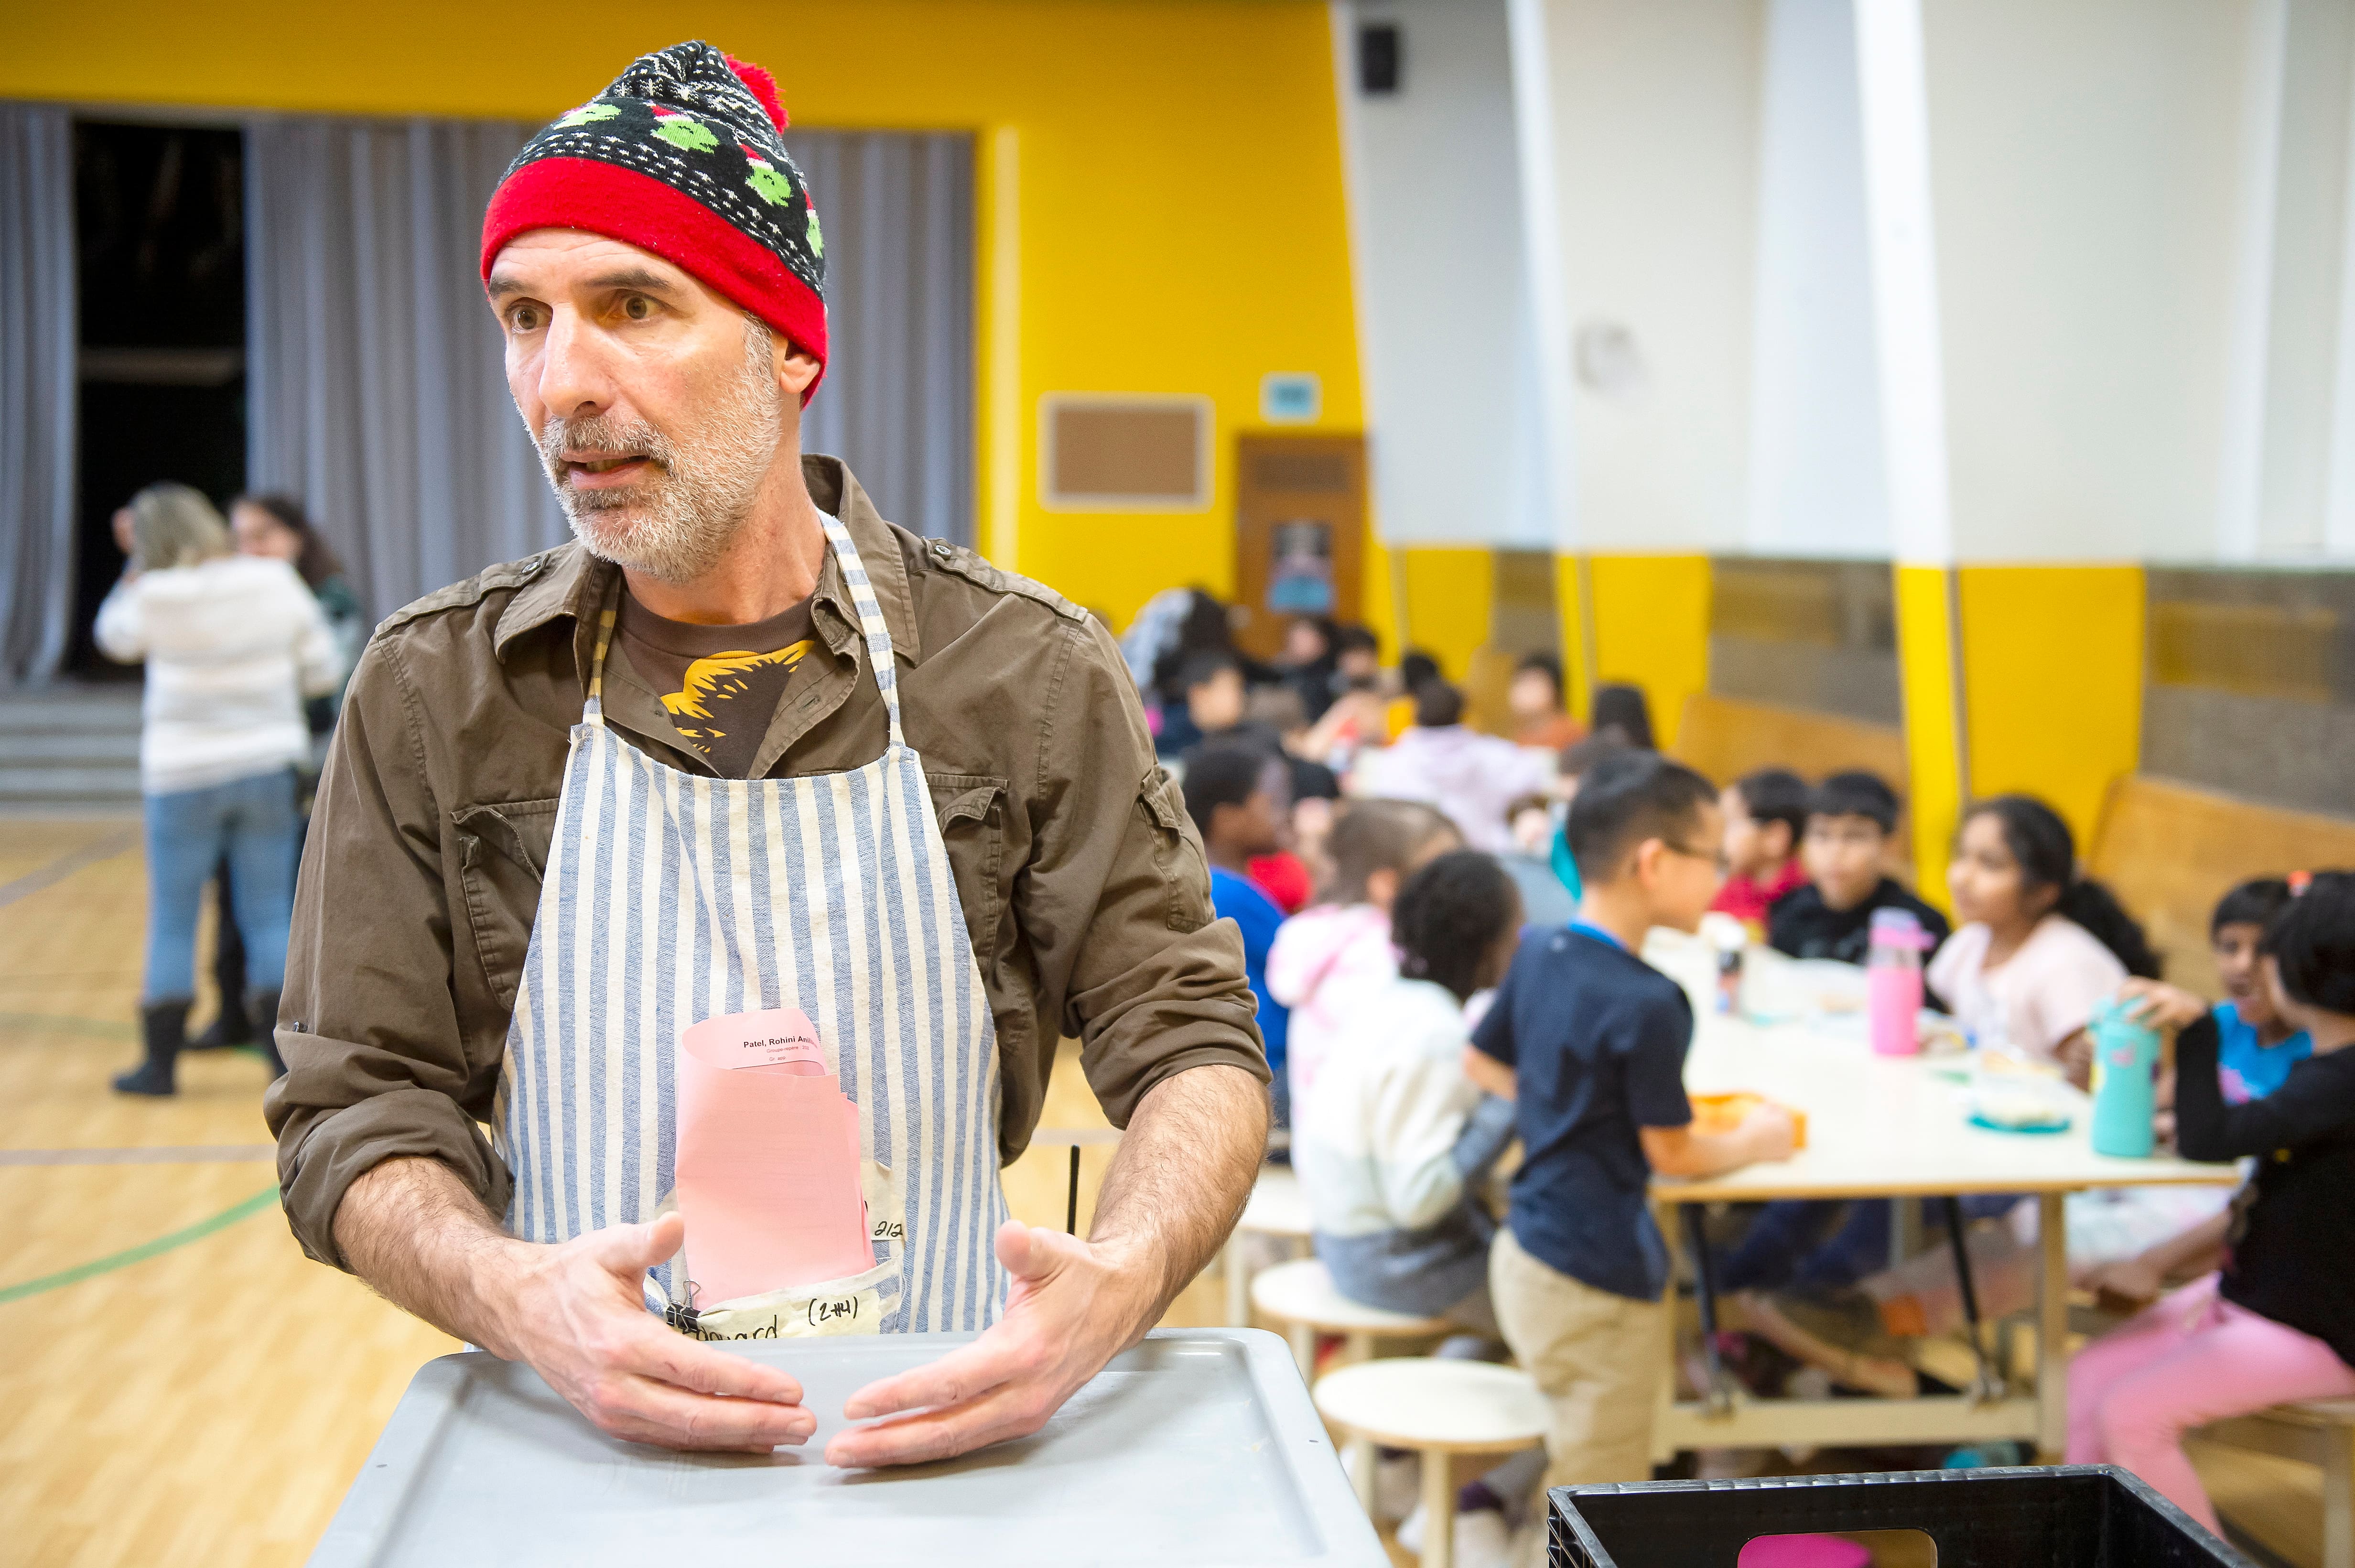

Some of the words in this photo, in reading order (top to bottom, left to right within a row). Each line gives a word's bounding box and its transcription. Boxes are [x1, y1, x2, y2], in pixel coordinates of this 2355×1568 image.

[744, 1039, 767, 1048] Patel,
[769, 1036, 795, 1045] Rohini
[875, 1221, 903, 1237] 212
